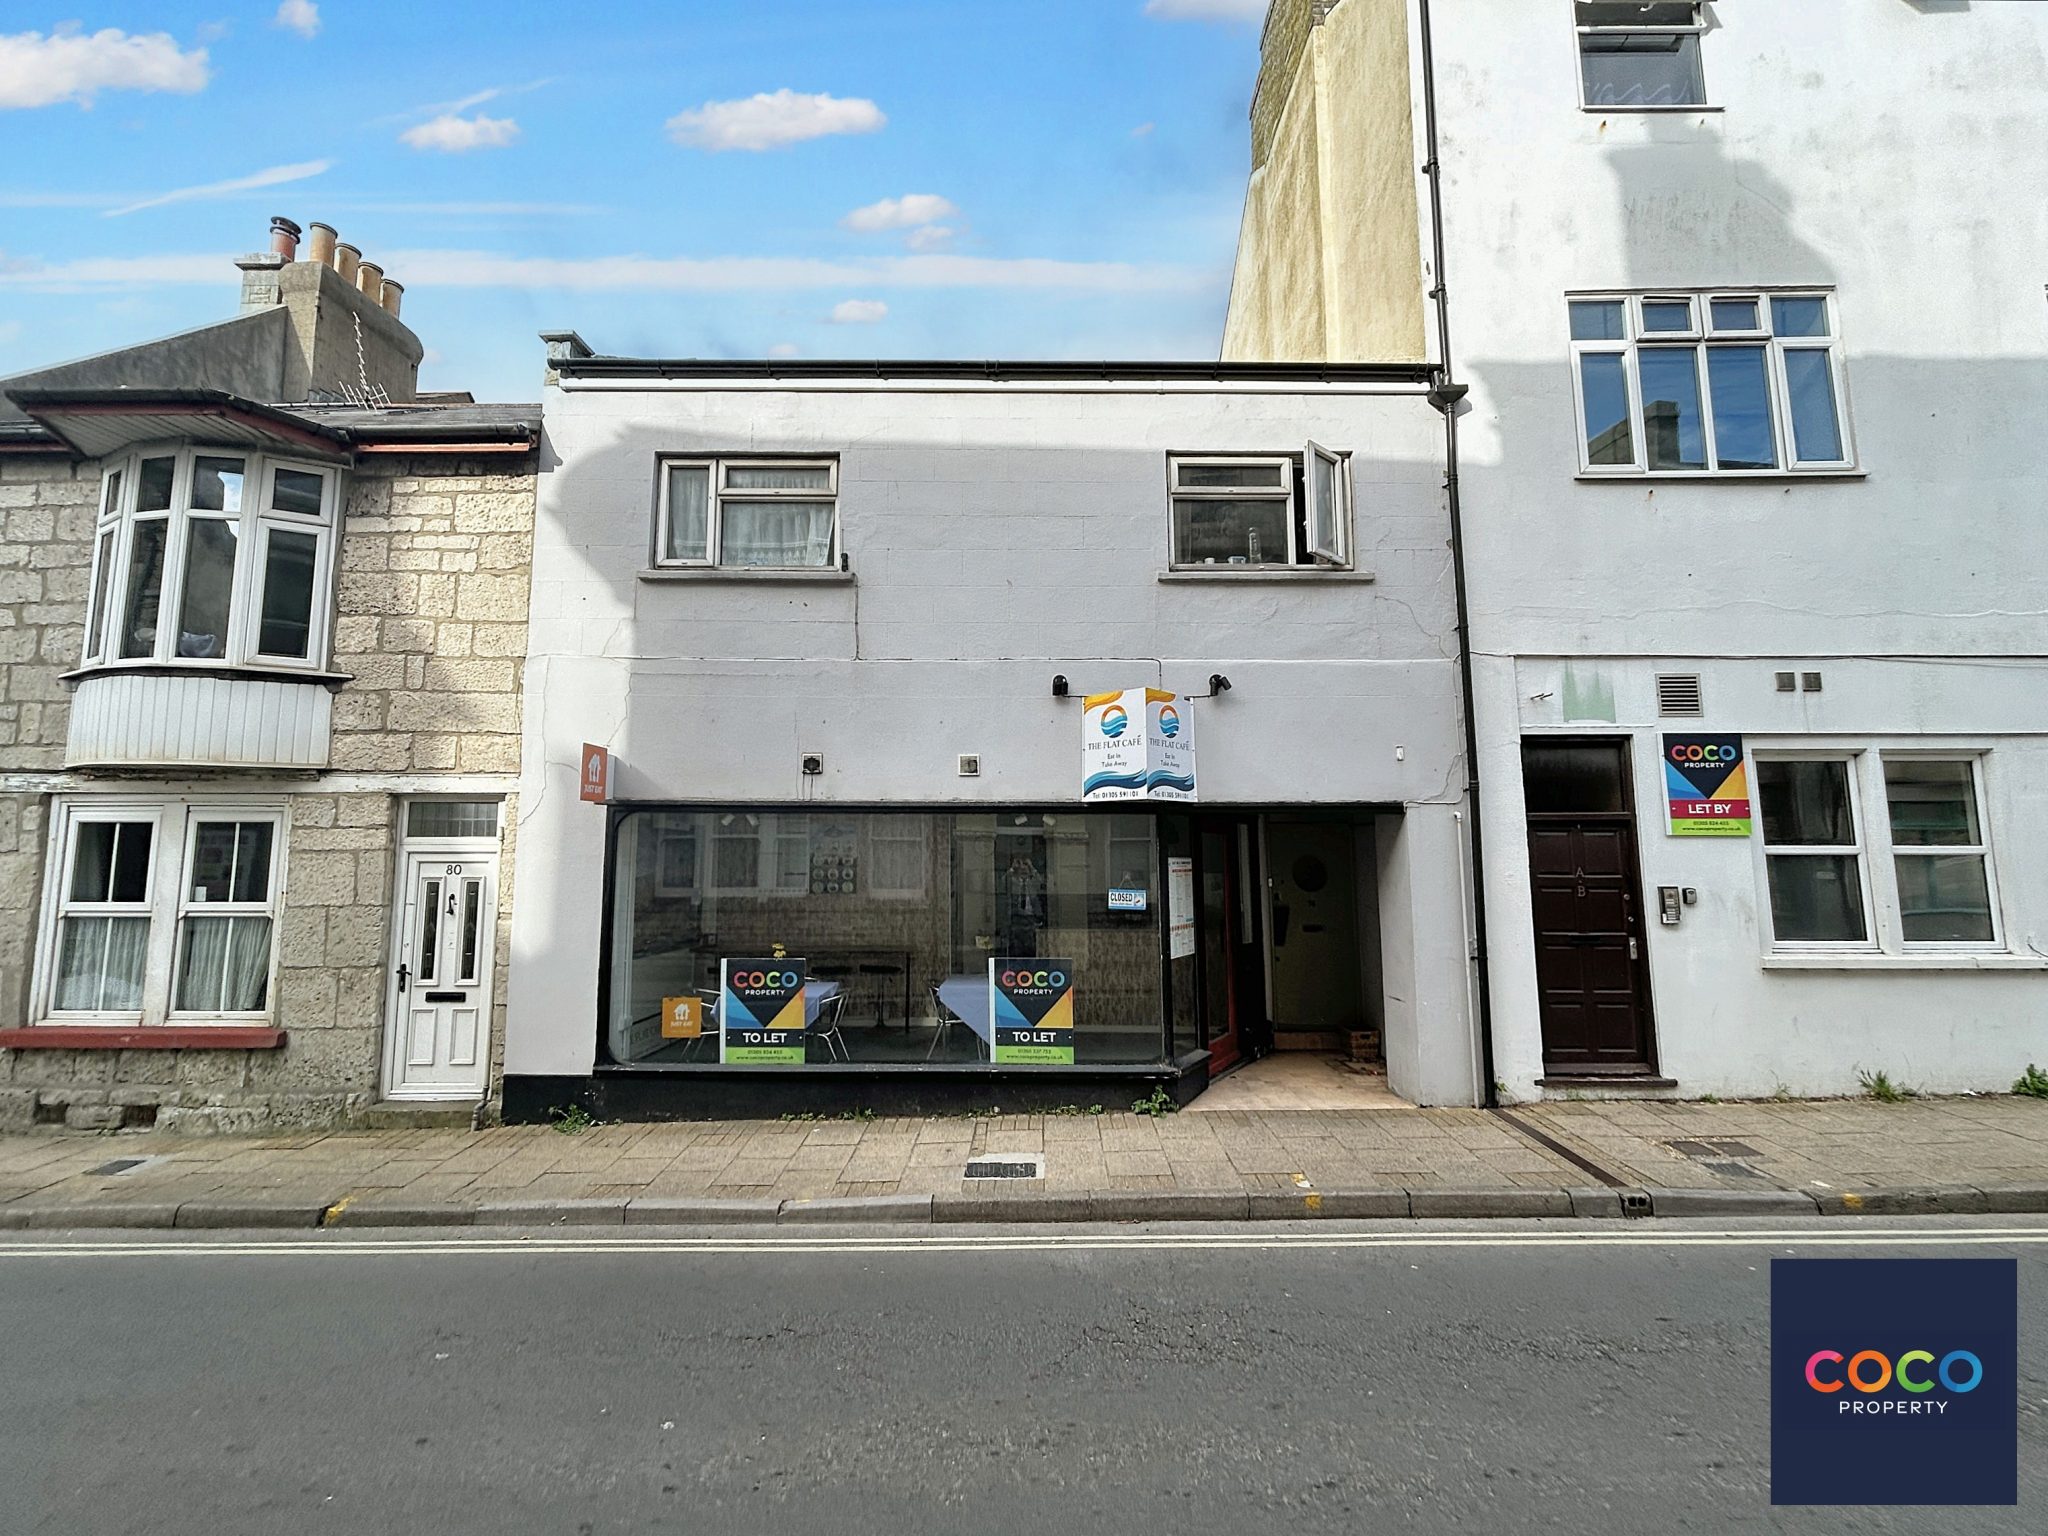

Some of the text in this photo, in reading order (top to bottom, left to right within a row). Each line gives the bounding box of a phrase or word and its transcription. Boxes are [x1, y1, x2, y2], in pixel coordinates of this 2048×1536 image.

[1088, 735, 1142, 750] THE FLAT CAFÉ
[1149, 738, 1190, 751] THE FLAT CAFÉ
[1671, 745, 1736, 760] COCO
[584, 784, 594, 794] JUST
[1688, 804, 1732, 814] LET BY
[446, 864, 462, 876] 80
[1576, 866, 1585, 878] A
[1110, 892, 1132, 902] CLOSED
[1578, 886, 1586, 897] B
[734, 971, 798, 988] COCO
[1002, 971, 1065, 987] COCO
[742, 1032, 787, 1042] TO LET
[1012, 1032, 1056, 1042] TO LET
